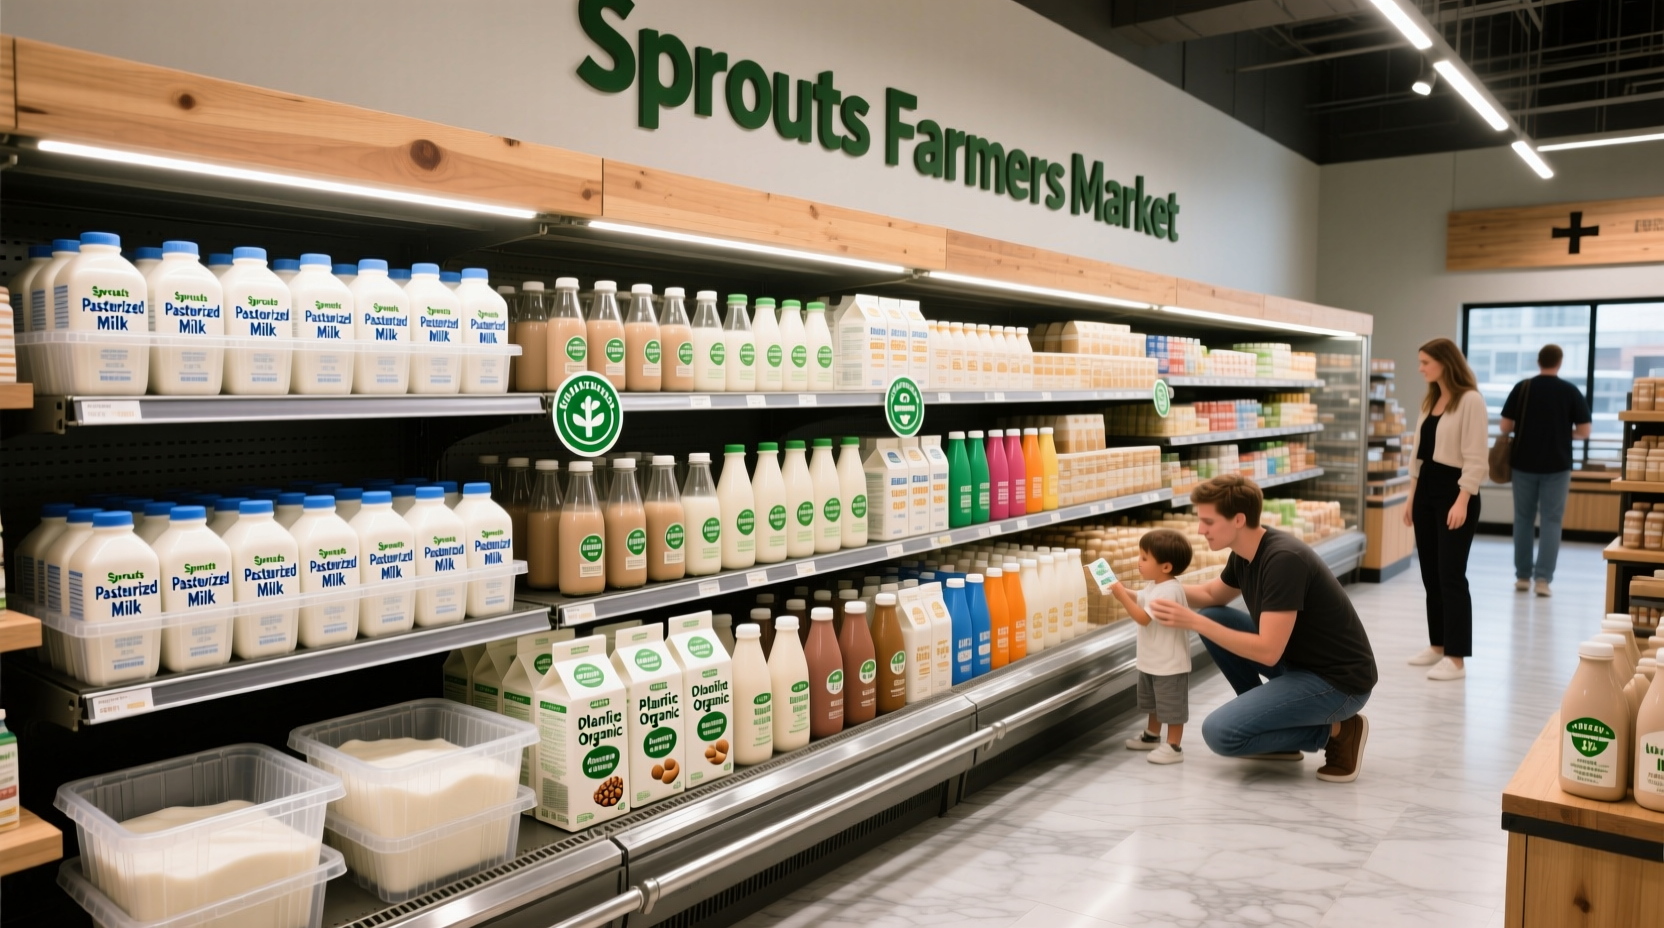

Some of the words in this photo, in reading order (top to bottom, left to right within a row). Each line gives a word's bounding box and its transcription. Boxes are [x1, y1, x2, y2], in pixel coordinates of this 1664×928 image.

[575, 0, 871, 156] Sprouts
[885, 87, 1066, 210] Farmers
[1070, 152, 1180, 242] Market
[97, 315, 128, 331] Milk
[179, 319, 206, 334] Milk
[250, 322, 277, 336] Milk
[317, 325, 341, 339] Milk
[376, 327, 398, 341] Milk
[322, 572, 346, 588] Milk
[381, 565, 403, 580] Milk
[257, 581, 284, 597] Milk
[188, 589, 216, 607] Milk
[112, 599, 142, 617] Milk
[640, 706, 680, 728] Organic
[578, 724, 623, 747] Organic
